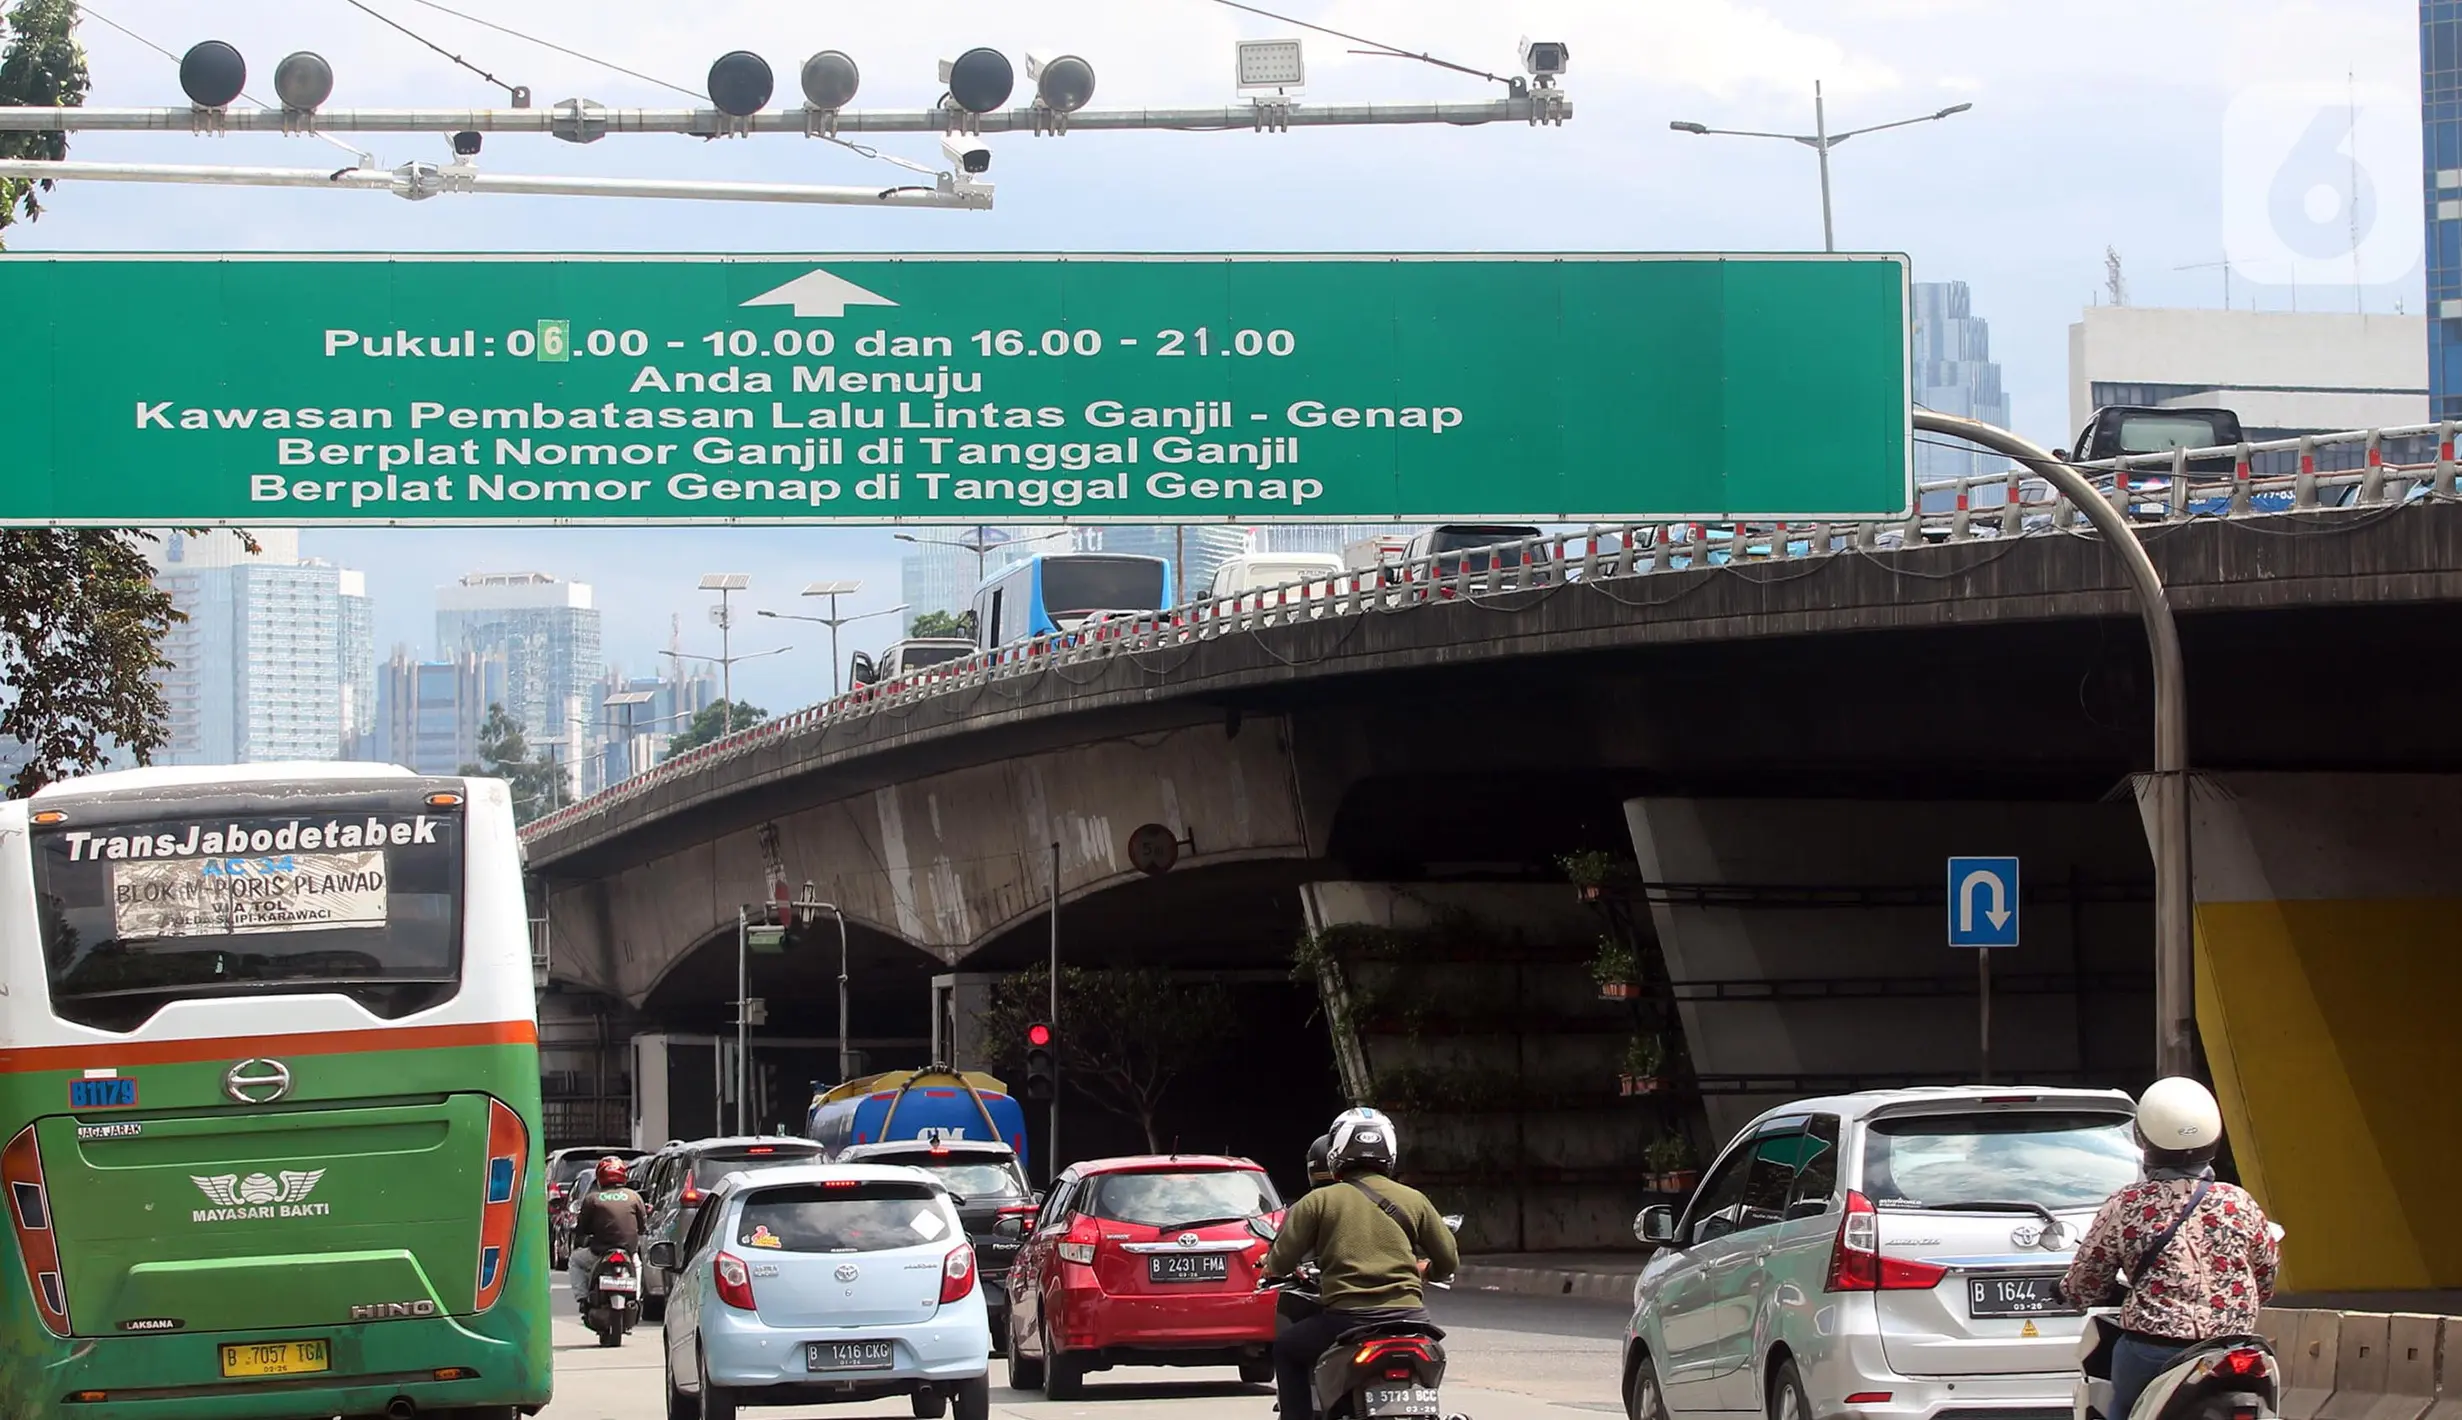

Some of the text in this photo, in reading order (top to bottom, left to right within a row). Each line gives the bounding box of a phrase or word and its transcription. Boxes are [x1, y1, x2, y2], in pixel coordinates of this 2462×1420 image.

[507, 325, 648, 357] 06.00
[703, 329, 834, 357] 10.00
[855, 329, 951, 357] dan
[972, 329, 1101, 357] 16.00
[1157, 328, 1294, 356] 21.00
[630, 366, 982, 399] Anda Menuju
[137, 401, 391, 429] Kawasan
[412, 401, 753, 429] Pembatasan
[773, 401, 883, 429] Lalu
[900, 401, 1064, 429] Lintas
[1085, 400, 1231, 434] Ganjil
[1287, 400, 1462, 434] Genap
[279, 437, 1297, 471] Berplat Nomor Ganjil di Tanggal Ganjil
[252, 472, 1323, 507] Berplat Nomor Genap di Tanggal Genap
[65, 815, 438, 861] TransJabodetabek
[202, 855, 295, 877] AC 34
[117, 882, 175, 904] BLOK
[295, 871, 383, 897] PLAWAD
[212, 900, 287, 914] VIA TOL
[193, 1203, 330, 1222] MAYASARI BAKTI
[1153, 1258, 1225, 1272] B 2431 FMA
[1975, 1281, 2036, 1302] B 1644
[351, 1300, 434, 1320] HINO
[126, 1319, 174, 1330] LAKSANA
[228, 1342, 324, 1366] B 7057 TGA
[810, 1343, 888, 1360] B 1416 CKG
[1365, 1389, 1437, 1403] B 5773 BCC
